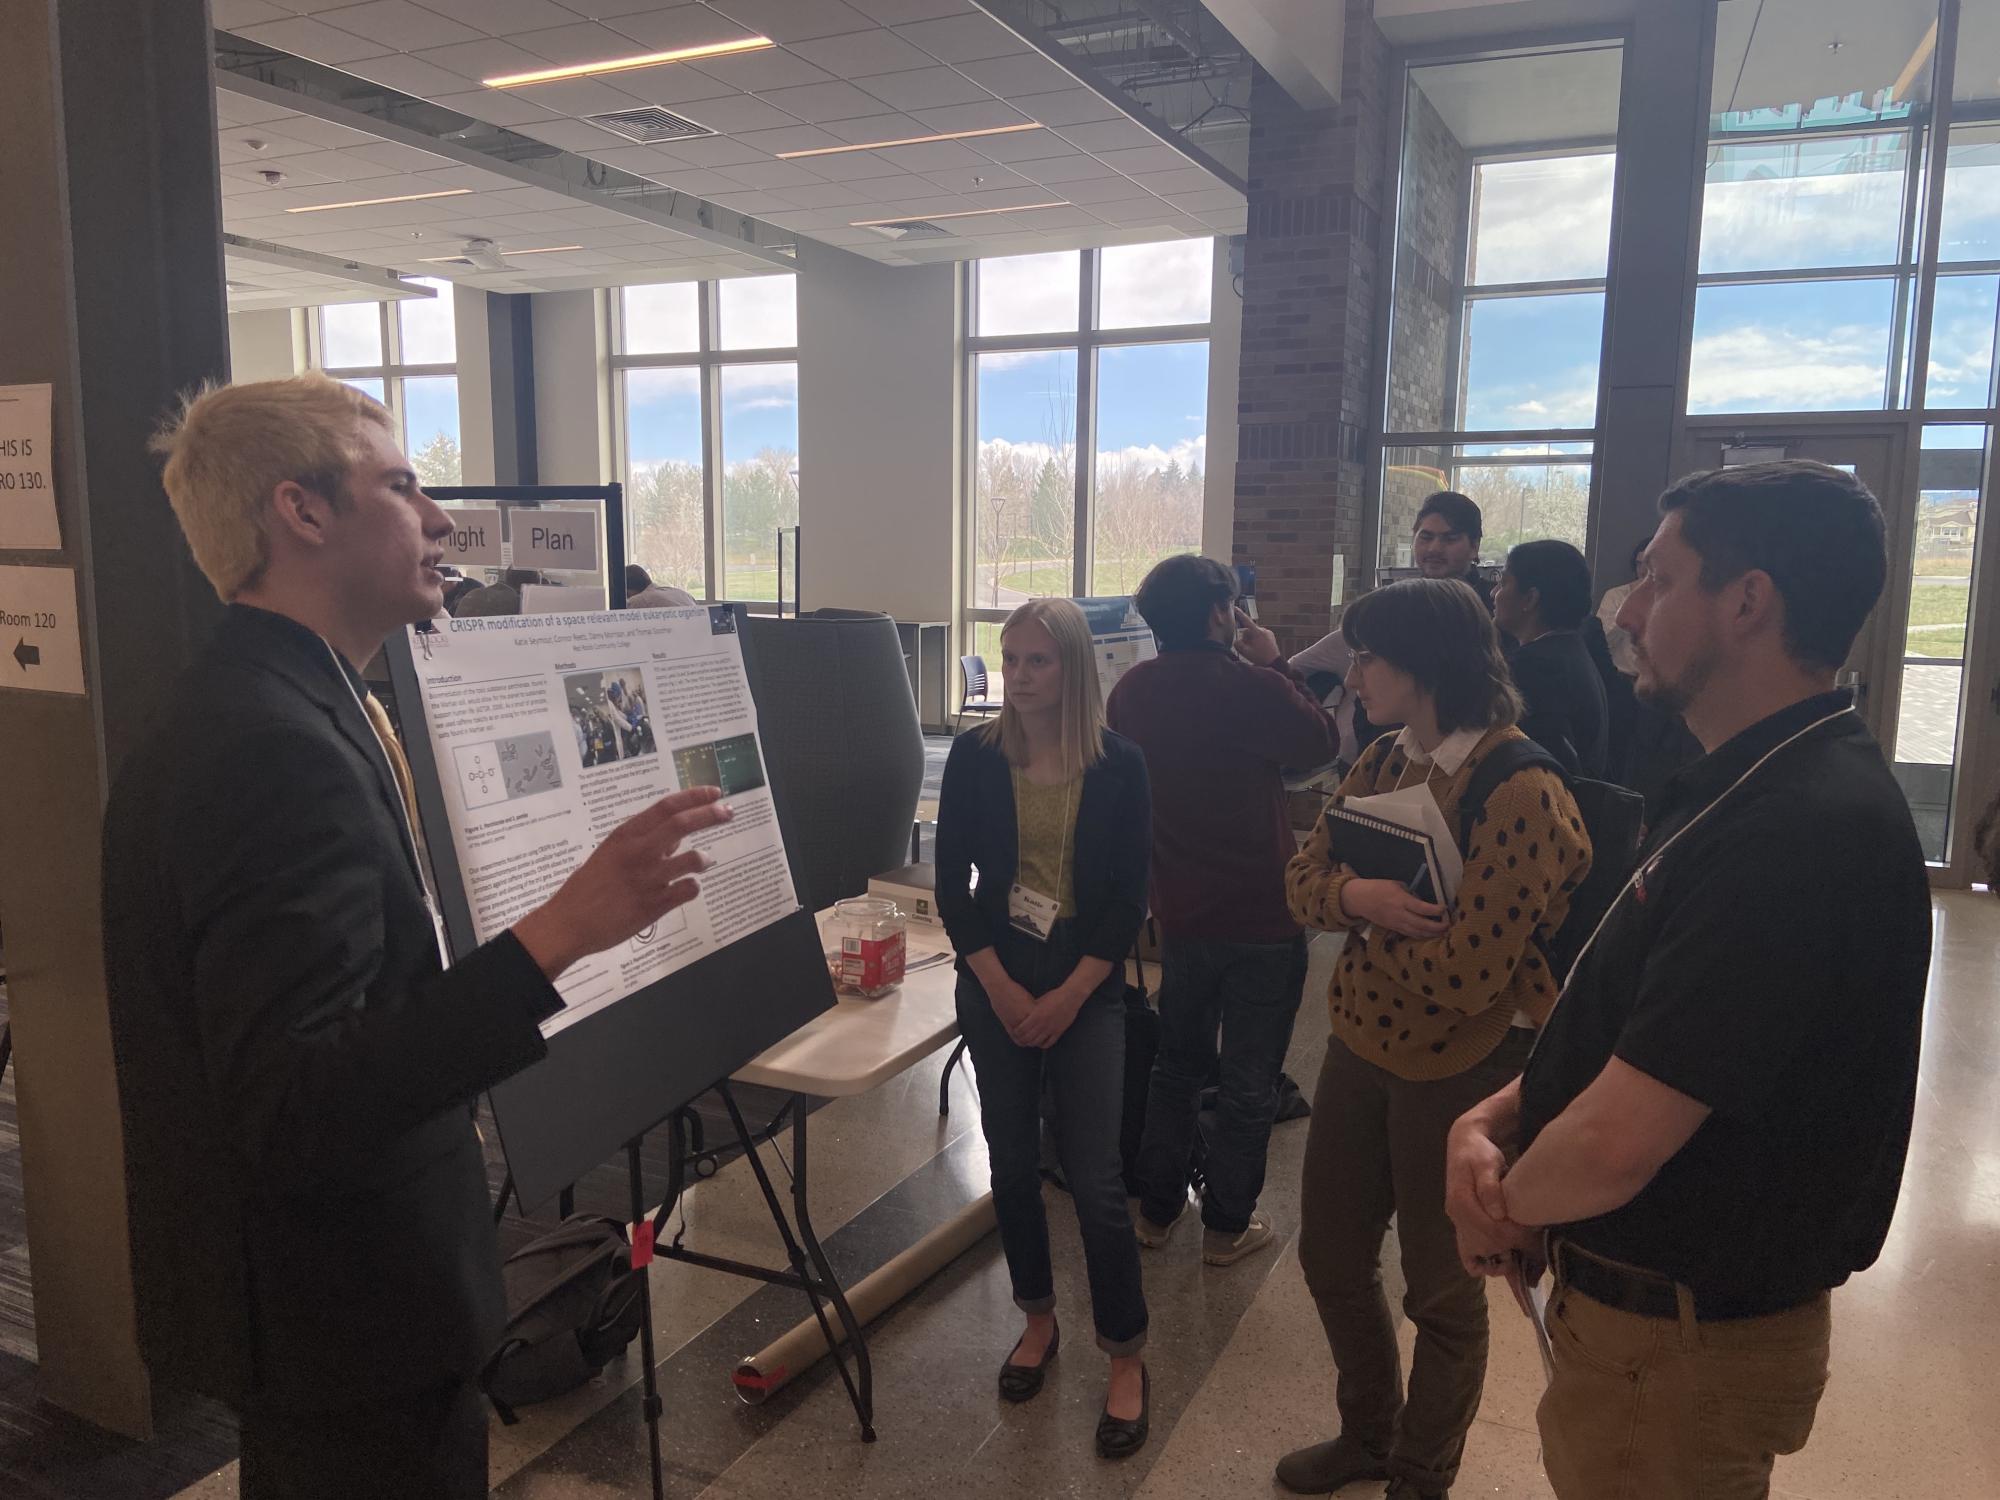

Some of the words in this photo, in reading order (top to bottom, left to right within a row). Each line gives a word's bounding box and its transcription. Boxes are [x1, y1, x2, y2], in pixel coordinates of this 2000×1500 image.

[21, 438, 33, 456] IS
[18, 471, 46, 490] 130.
[531, 527, 574, 551] Plan
[0, 610, 31, 627] Room
[35, 612, 56, 628] 120
[450, 618, 486, 632] CRISPR
[487, 616, 544, 631] modification
[545, 615, 555, 626] of
[556, 617, 561, 625] a
[563, 615, 586, 628] space
[587, 612, 617, 623] relevant
[619, 610, 642, 621] model
[643, 609, 677, 621] eukaryotic
[679, 607, 705, 619] organism
[426, 674, 462, 685] Introduction
